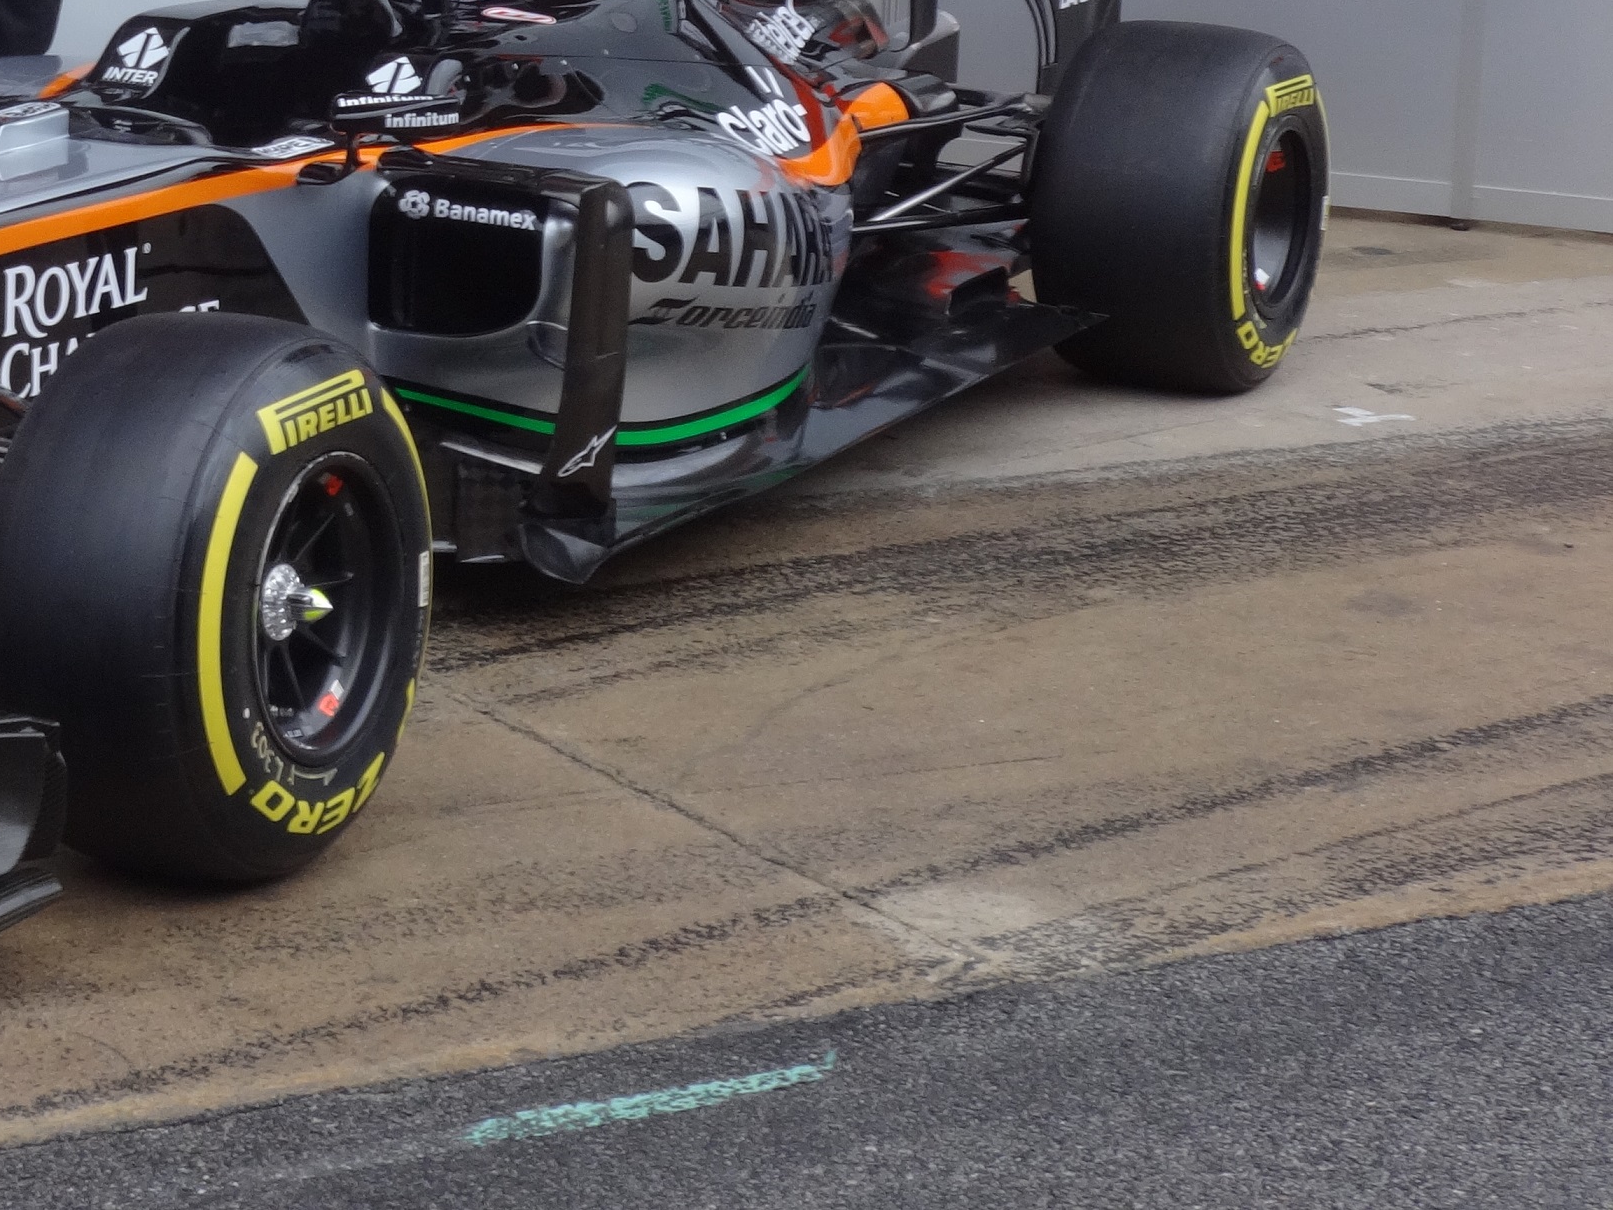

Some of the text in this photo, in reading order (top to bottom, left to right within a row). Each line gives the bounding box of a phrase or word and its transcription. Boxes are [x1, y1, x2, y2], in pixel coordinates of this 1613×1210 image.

[101, 66, 160, 87] INTER
[383, 111, 460, 129] infinitum
[715, 96, 811, 157] Claro
[433, 198, 538, 232] Banamex
[0, 246, 148, 339] ROYAL
[255, 368, 375, 456] PIRELLI
[249, 751, 386, 836] ZERO
